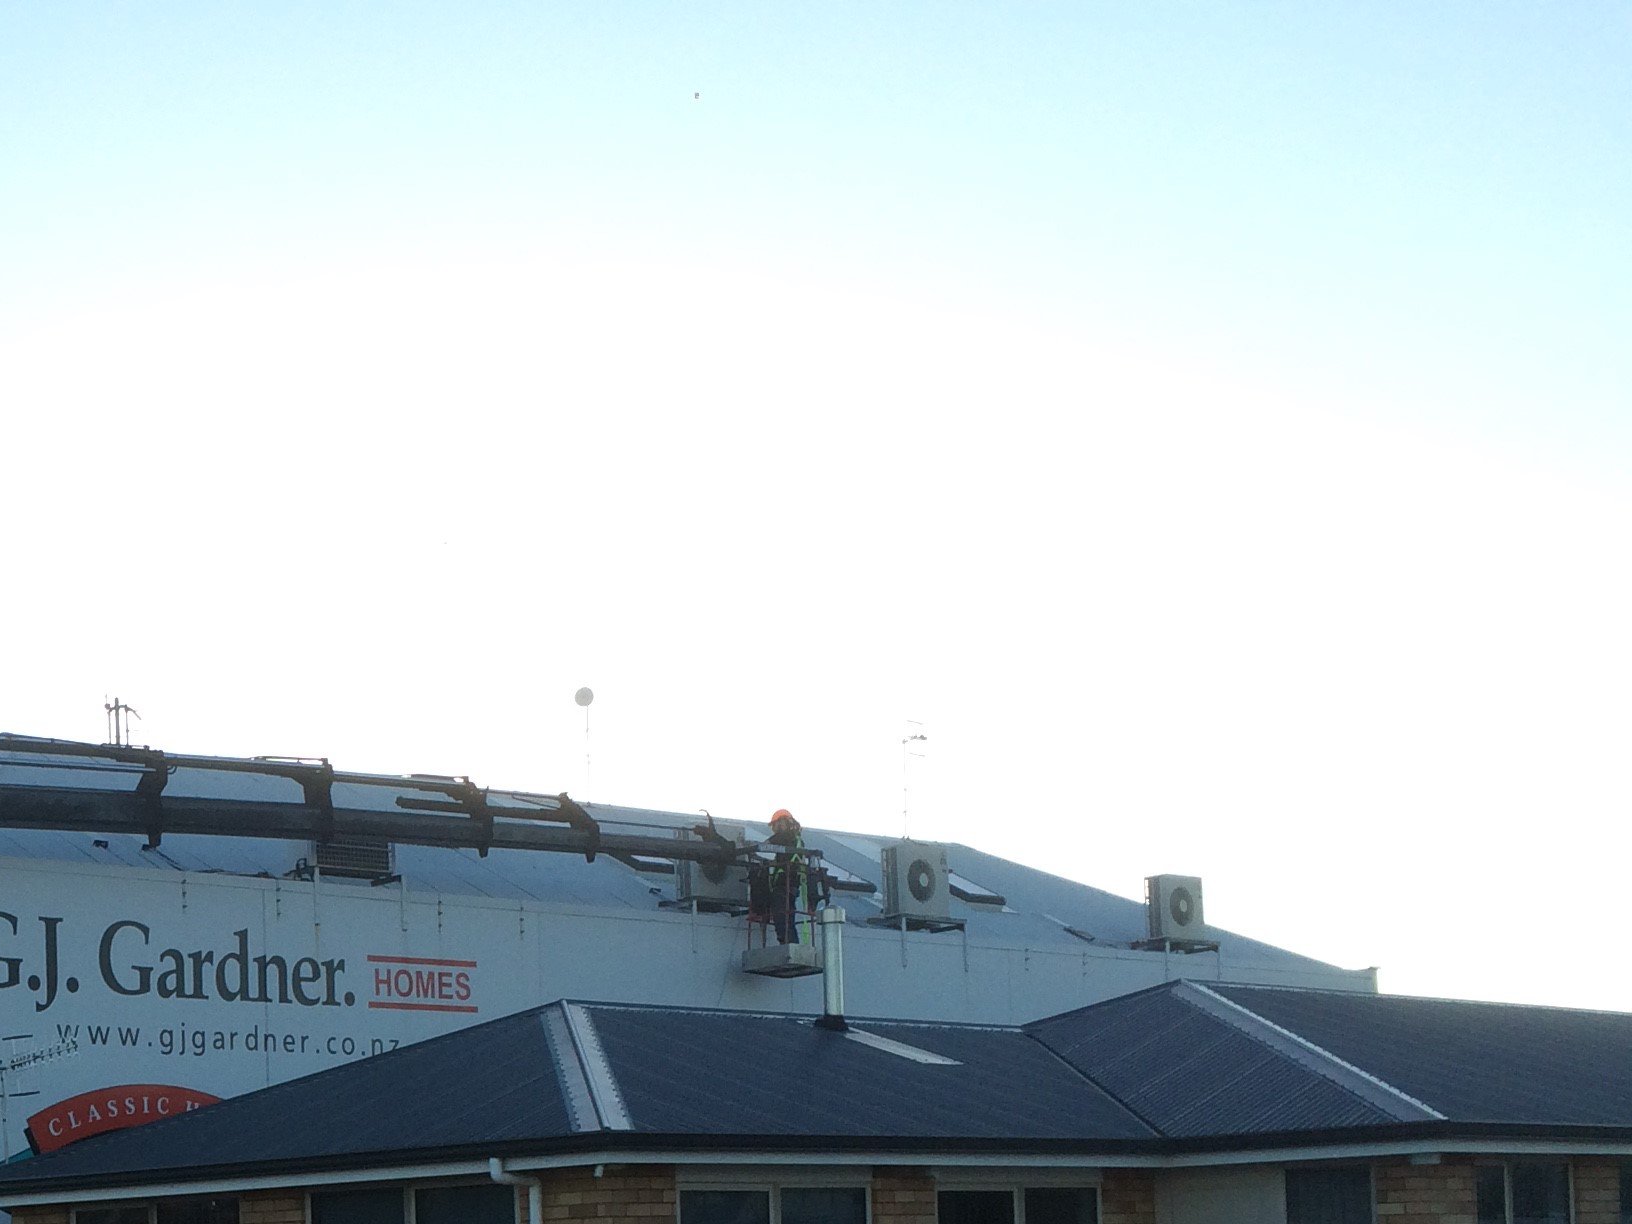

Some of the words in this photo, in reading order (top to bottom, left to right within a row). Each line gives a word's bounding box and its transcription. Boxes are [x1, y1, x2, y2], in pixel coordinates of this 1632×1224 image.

[97, 919, 357, 1009] Gardner.
[374, 968, 472, 1001] HOMES
[48, 1096, 170, 1137] CLASSIC
